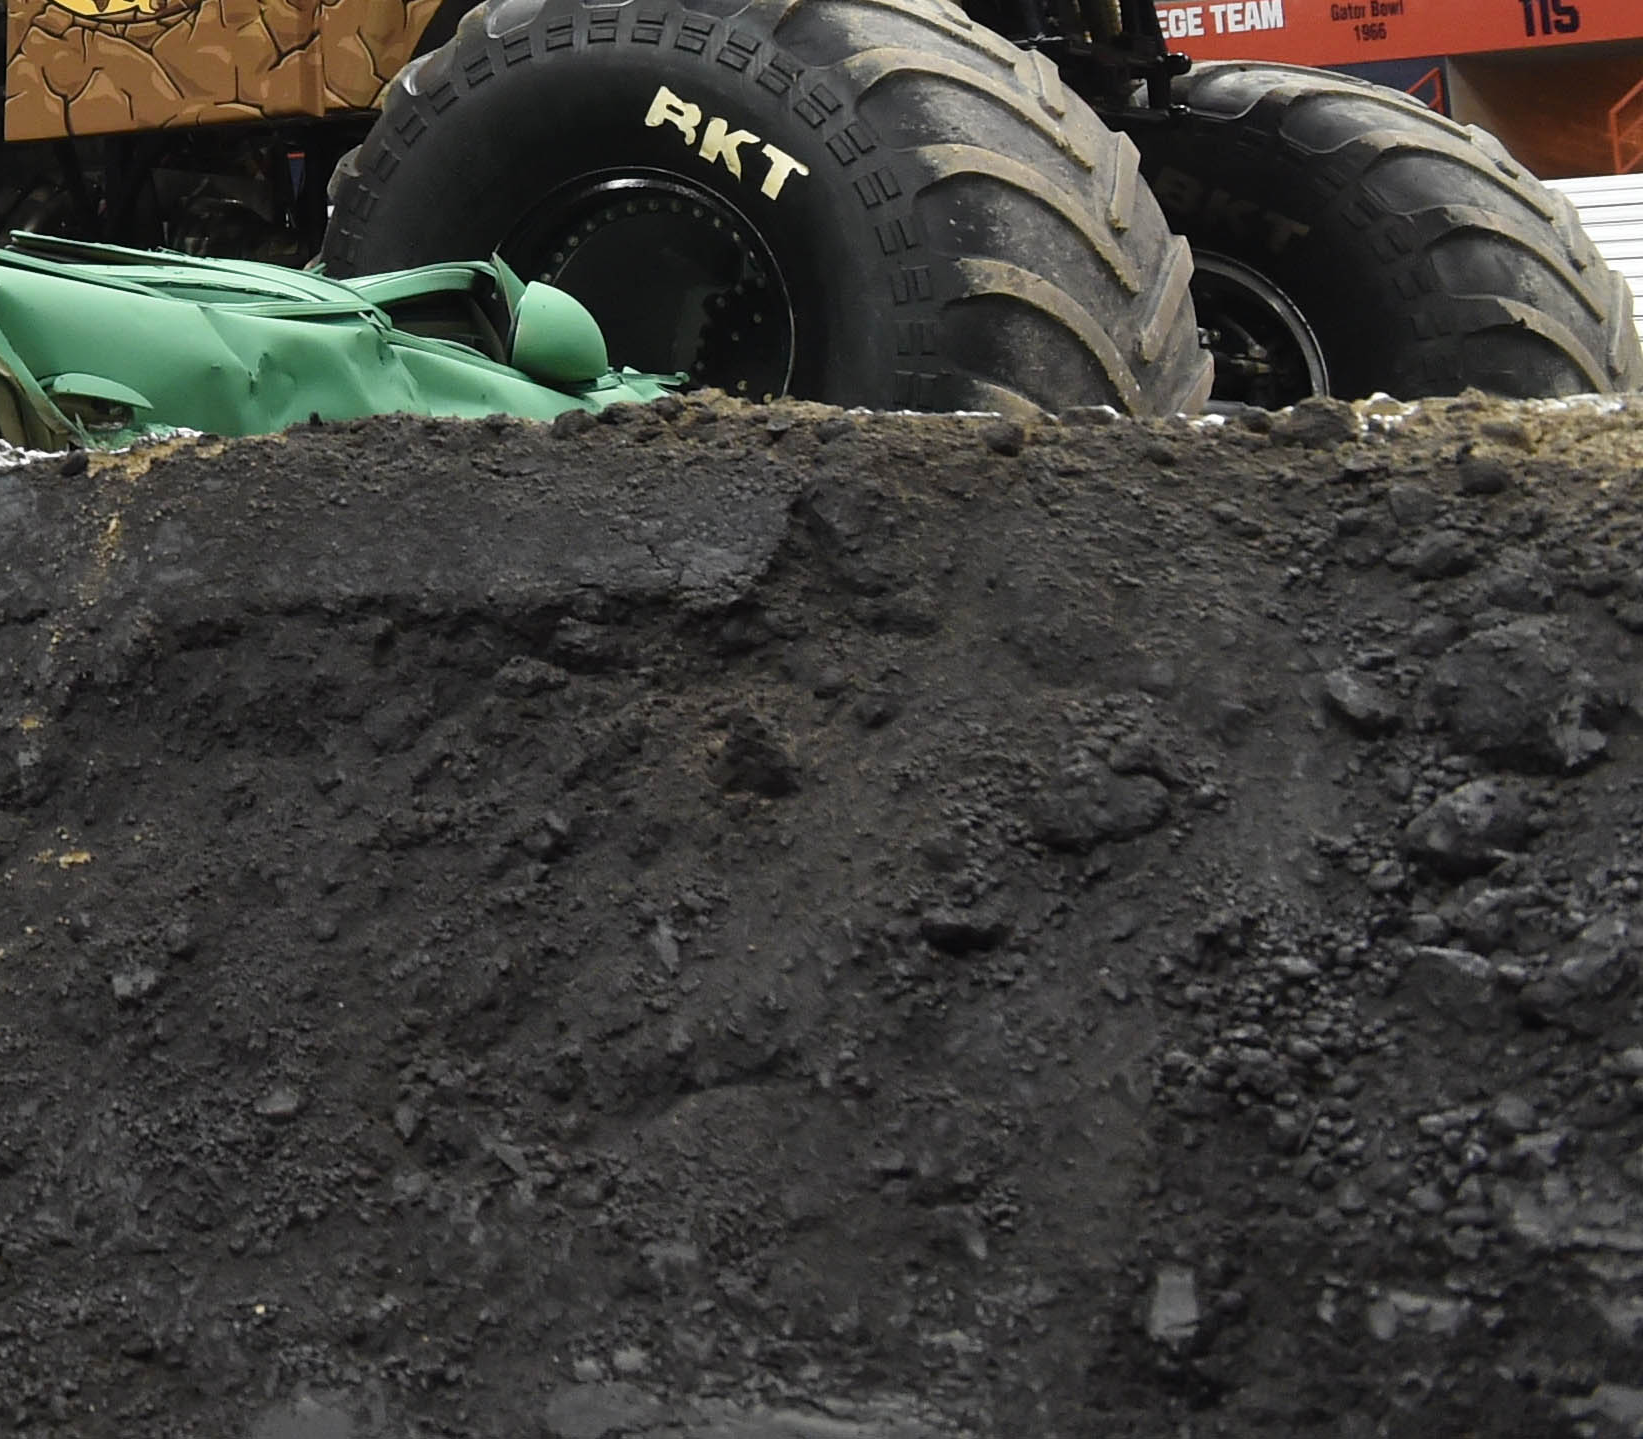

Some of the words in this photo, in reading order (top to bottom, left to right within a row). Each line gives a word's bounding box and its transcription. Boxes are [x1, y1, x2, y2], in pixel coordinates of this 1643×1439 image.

[1210, 0, 1284, 34] TEAM
[1331, 2, 1366, 22] Gator
[1353, 22, 1387, 42] 1966
